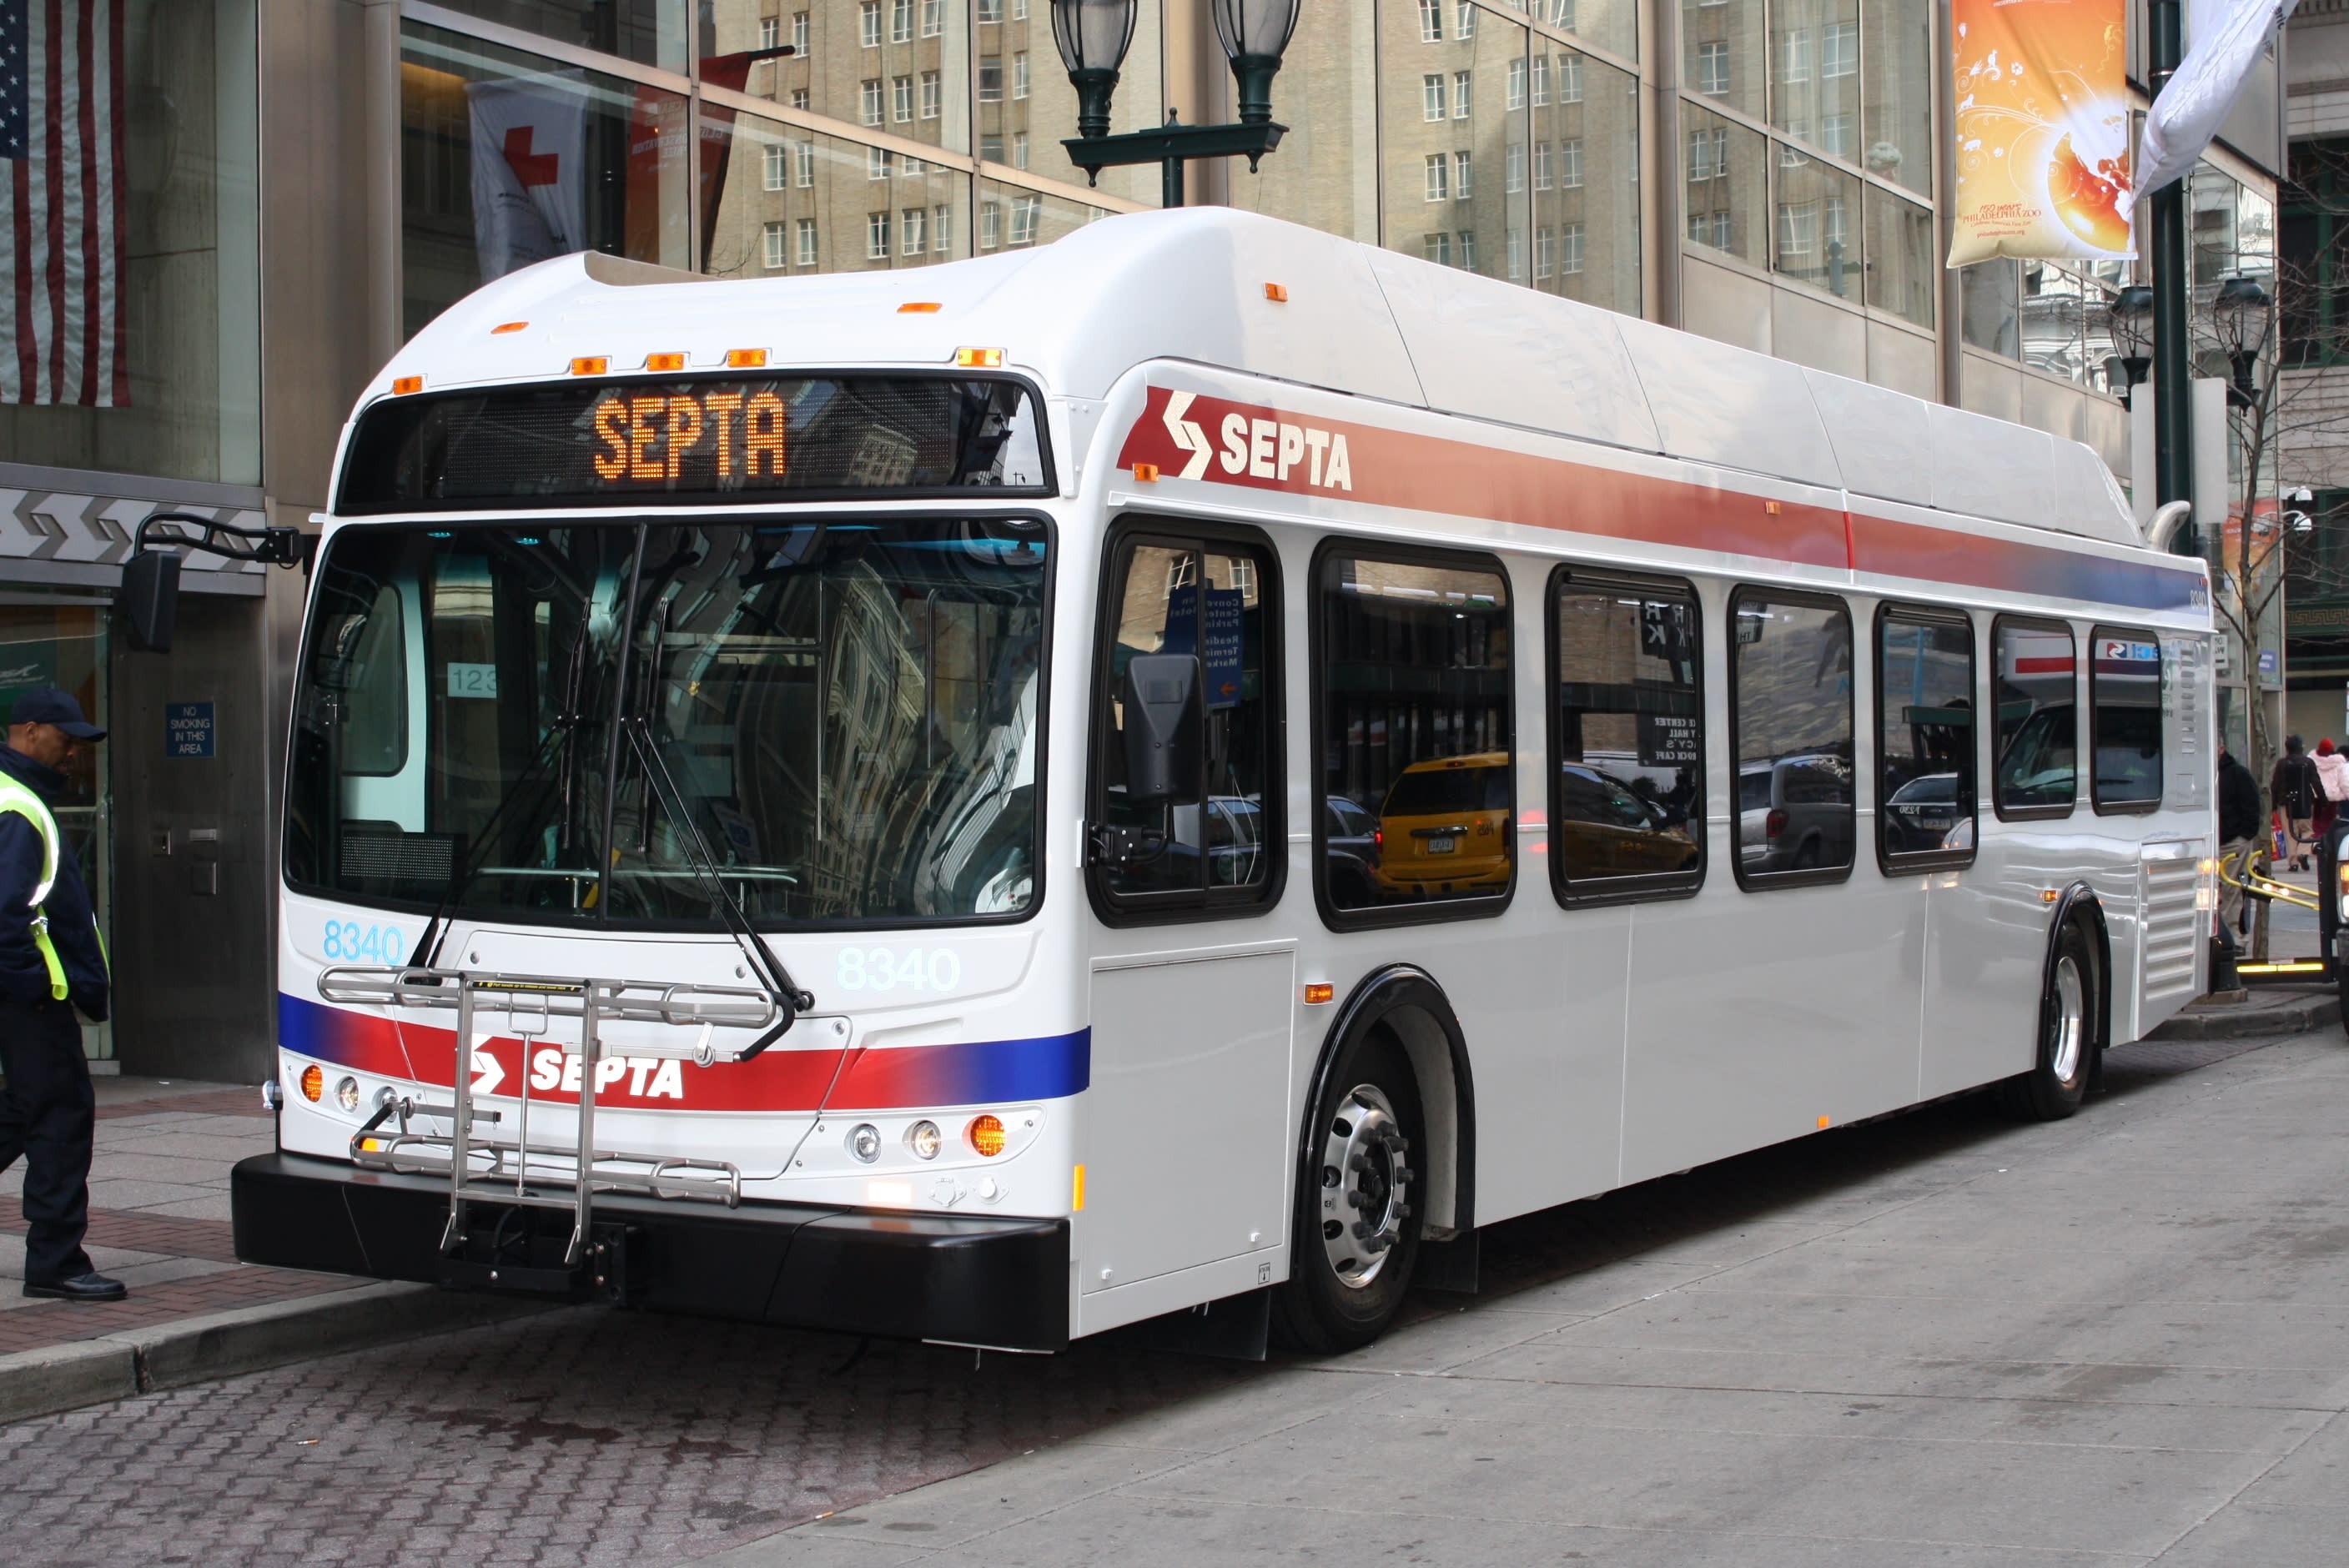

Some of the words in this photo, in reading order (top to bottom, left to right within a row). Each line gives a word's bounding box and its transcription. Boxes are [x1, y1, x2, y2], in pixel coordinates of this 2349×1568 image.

[1963, 209, 2020, 224] PHILADELPHIA
[2021, 209, 2042, 218] ZOO
[595, 393, 784, 480] SEPTA
[1220, 413, 1352, 491] SEPTA
[170, 718, 210, 729] SMOKING
[183, 706, 197, 716] NO
[175, 731, 184, 741] IN
[186, 731, 205, 741] THIS
[179, 743, 202, 755] AREA
[323, 919, 404, 967] 8340
[837, 947, 960, 991] 8340
[530, 1048, 683, 1099] SEPTA
